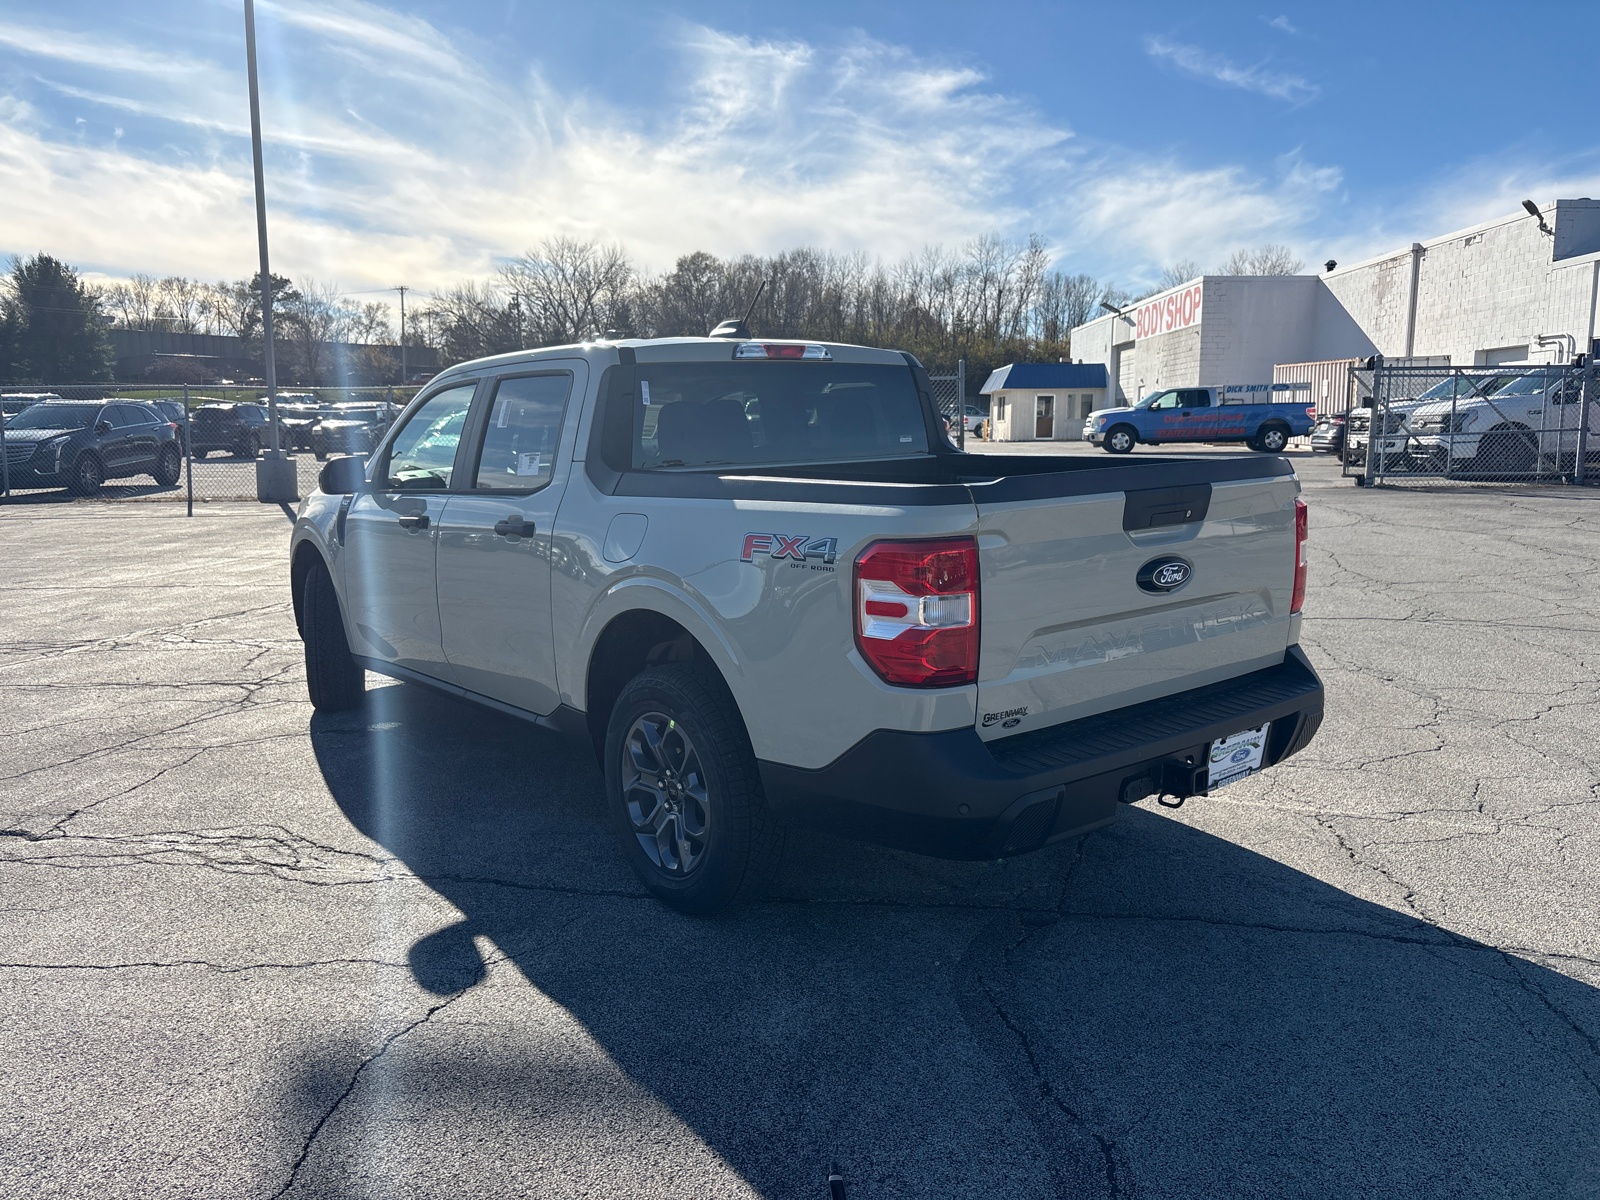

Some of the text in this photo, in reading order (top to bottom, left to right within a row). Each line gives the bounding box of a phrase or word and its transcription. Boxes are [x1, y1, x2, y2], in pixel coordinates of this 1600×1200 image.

[1226, 385, 1244, 393] DICK
[1246, 384, 1269, 393] SMITH
[1219, 412, 1244, 421] Ford
[740, 532, 838, 564] FX4
[810, 564, 835, 573] ROAD
[1160, 566, 1185, 583] Ford
[1034, 601, 1258, 667] MAVERICK
[983, 706, 1028, 723] GREENWAY
